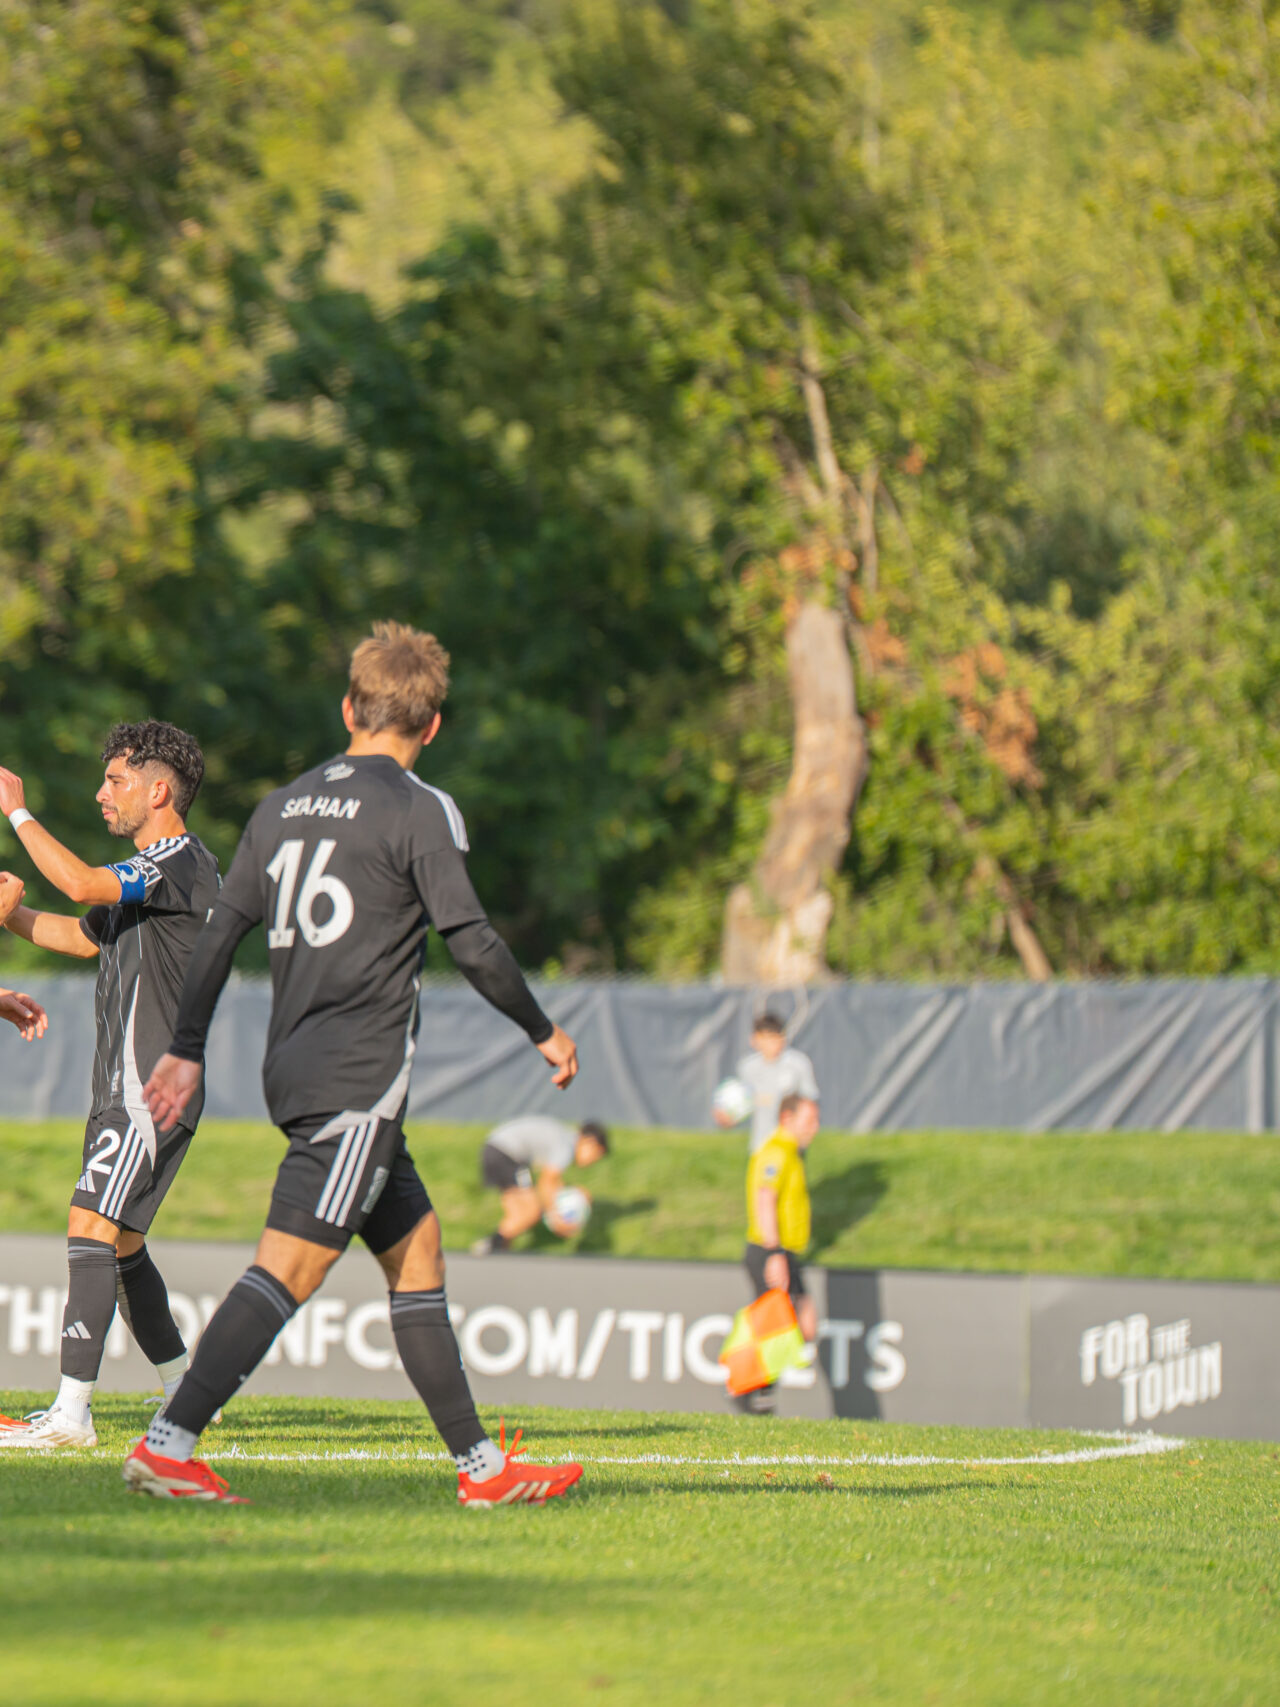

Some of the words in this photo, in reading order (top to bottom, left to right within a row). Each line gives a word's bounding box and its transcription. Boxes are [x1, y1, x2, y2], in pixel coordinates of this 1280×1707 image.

[281, 795, 361, 819] SKAHAN
[266, 838, 355, 949] 16
[1080, 1312, 1150, 1387] FOR
[1151, 1318, 1191, 1361] THE
[1119, 1341, 1222, 1427] TOWN
